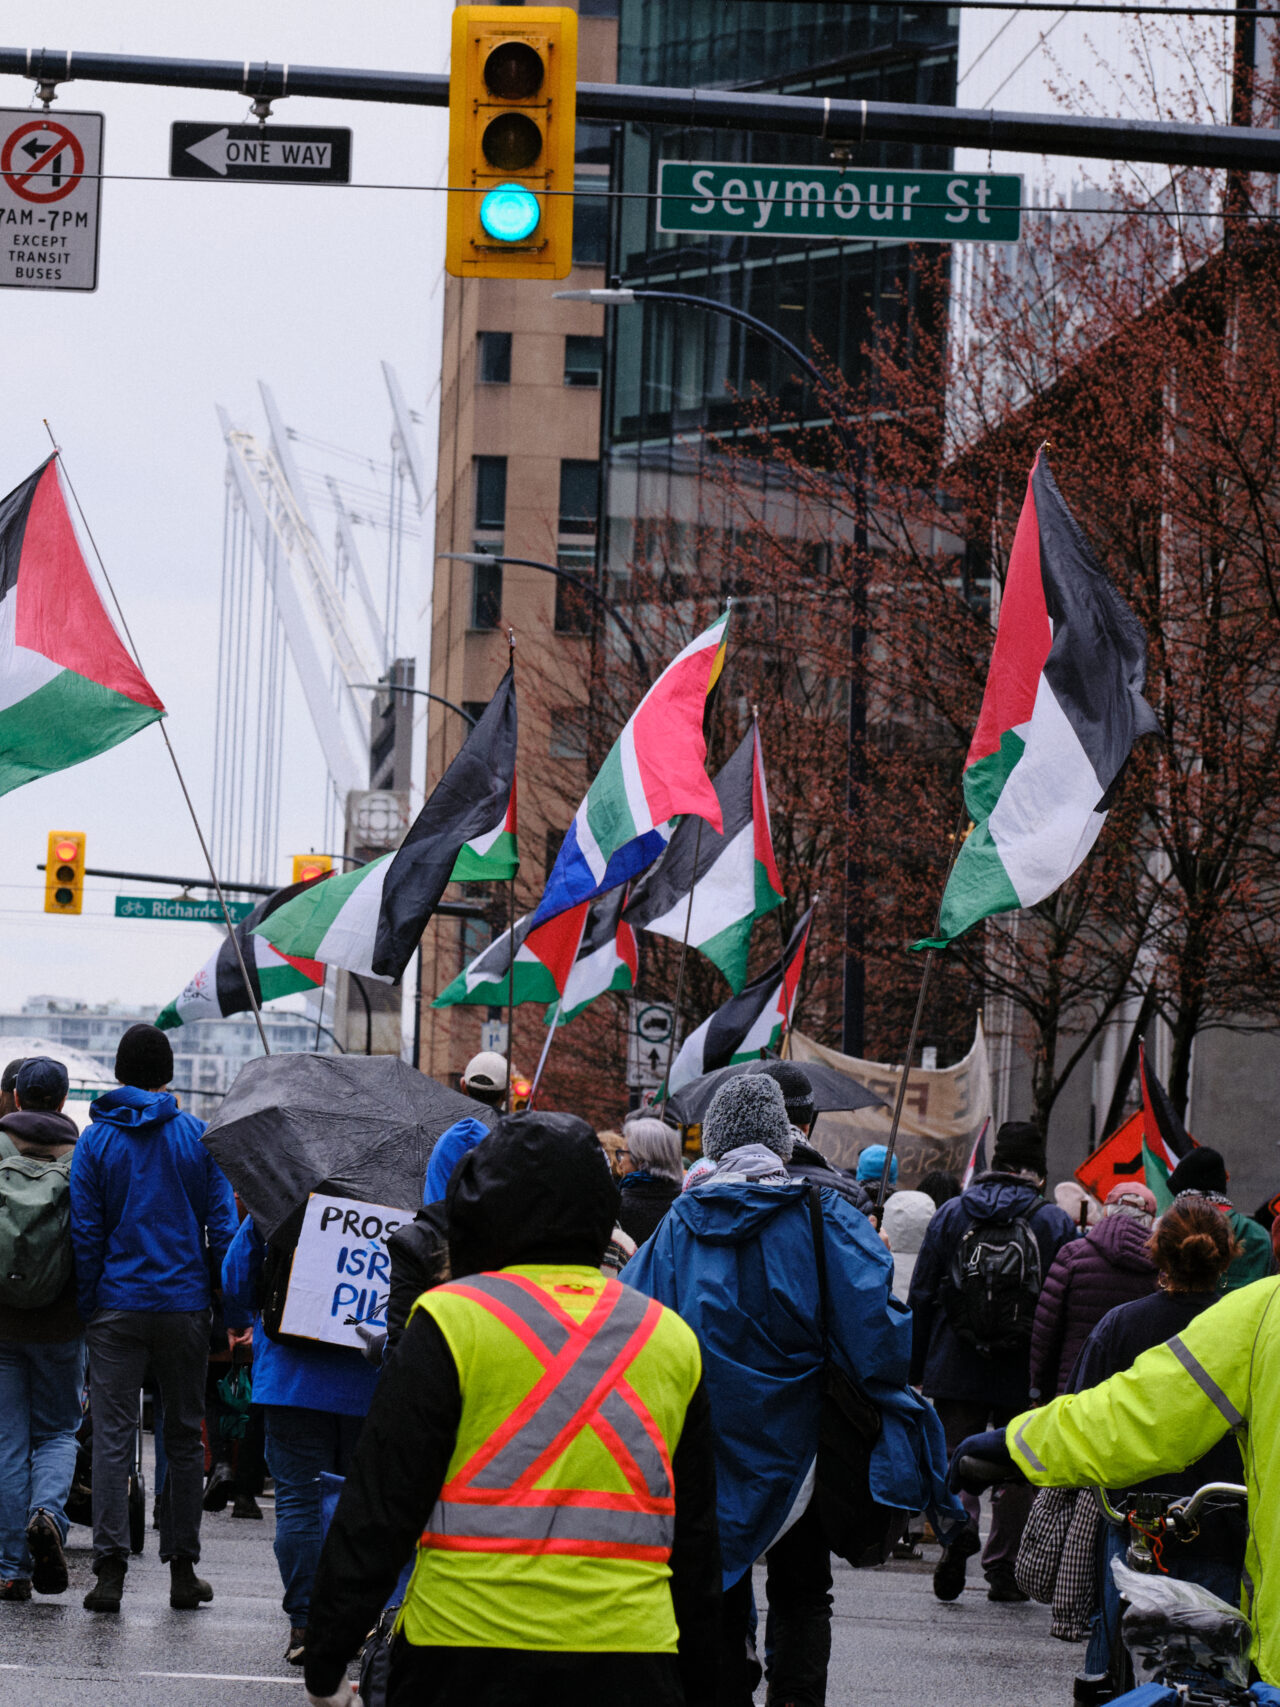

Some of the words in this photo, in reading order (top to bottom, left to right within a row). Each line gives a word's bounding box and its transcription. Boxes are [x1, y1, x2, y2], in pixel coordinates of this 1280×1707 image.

[226, 142, 271, 163] ONE
[282, 144, 328, 165] WAY
[689, 169, 920, 229] Seymour
[944, 178, 992, 224] St
[13, 234, 68, 248] EXCEPT
[8, 250, 72, 264] TRANSIT
[15, 266, 62, 280] BUSES
[152, 901, 218, 919] Richards
[331, 1282, 389, 1328] PIL
